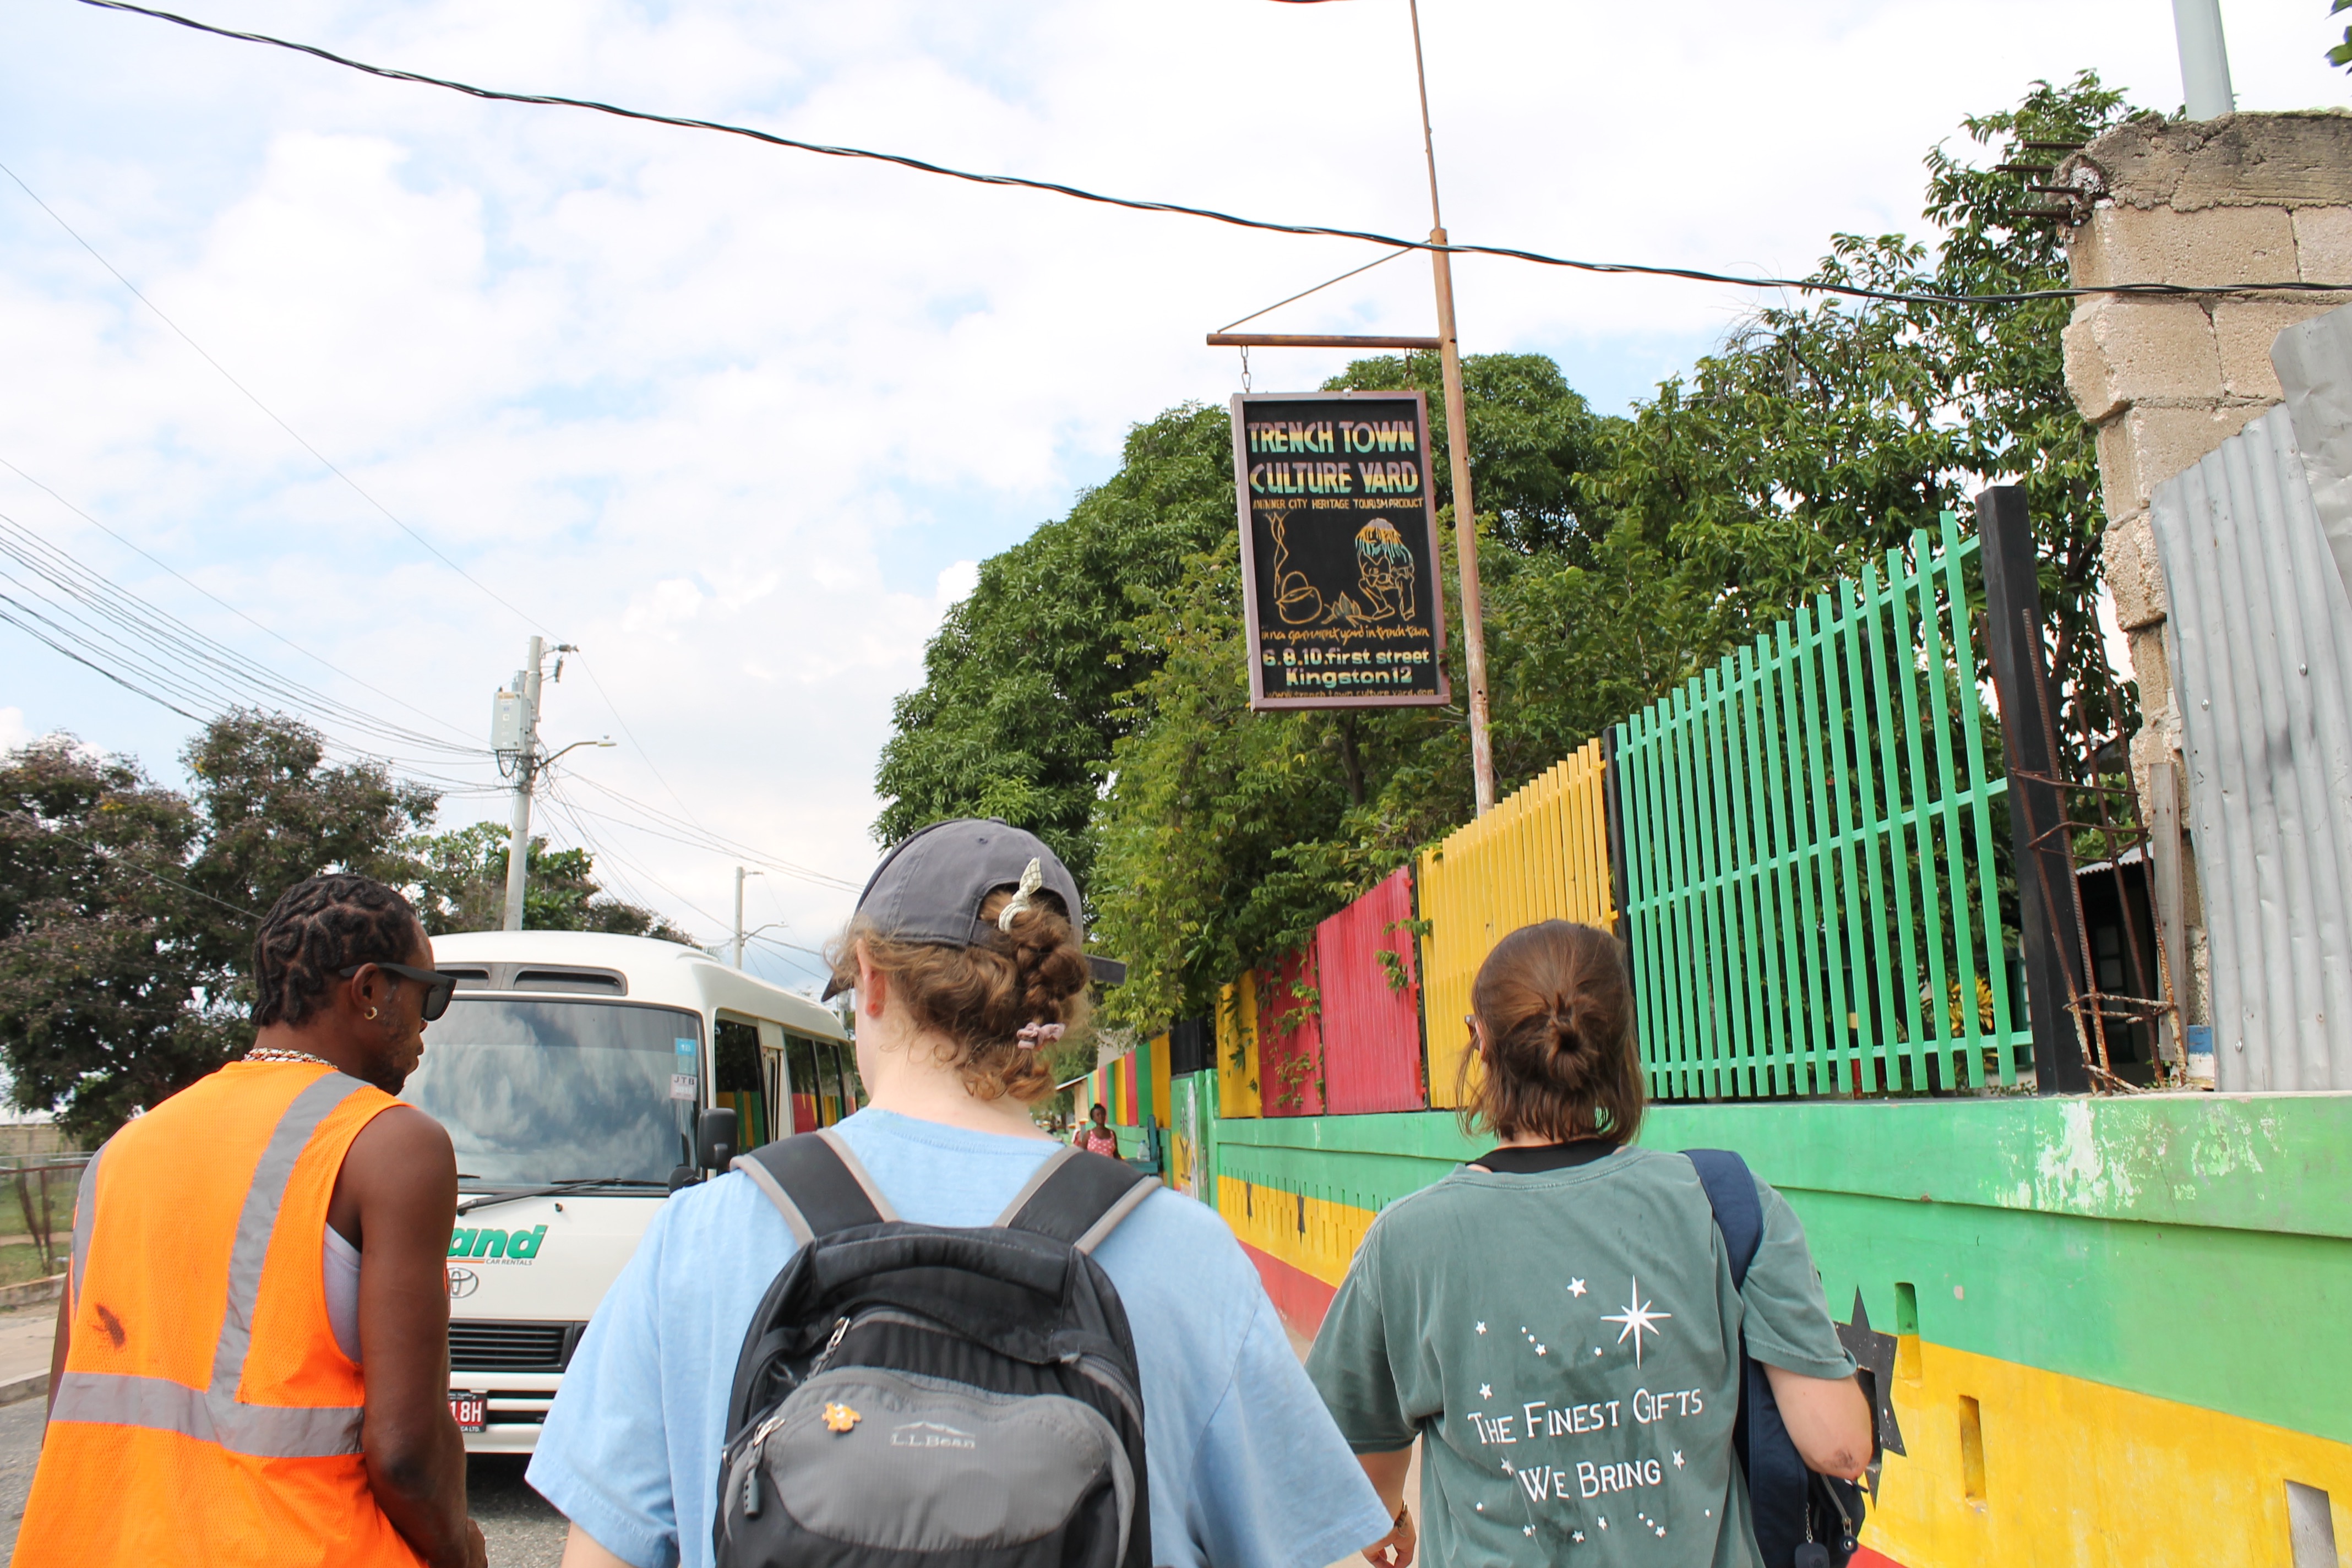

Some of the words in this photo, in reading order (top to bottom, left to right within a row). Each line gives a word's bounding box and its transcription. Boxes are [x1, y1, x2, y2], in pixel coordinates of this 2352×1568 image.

[1246, 421, 1334, 453] TRENCH
[1338, 421, 1415, 453] TOWN
[1249, 461, 1352, 494] CULTURE
[1358, 461, 1418, 493] YARD
[1288, 498, 1308, 509] CITY
[1311, 498, 1350, 509] HERITAGE
[1353, 498, 1388, 509] TOURISM
[1389, 497, 1424, 508] PRODUCT
[1340, 624, 1364, 646] yard
[1376, 646, 1430, 665] street
[447, 1224, 549, 1259] and
[450, 1400, 482, 1423] 18H
[1467, 1411, 1517, 1445] THE
[1523, 1400, 1620, 1439] FINEST
[1632, 1387, 1705, 1425] GIFTS
[1518, 1464, 1570, 1503] WE
[1576, 1458, 1662, 1499] BRING
